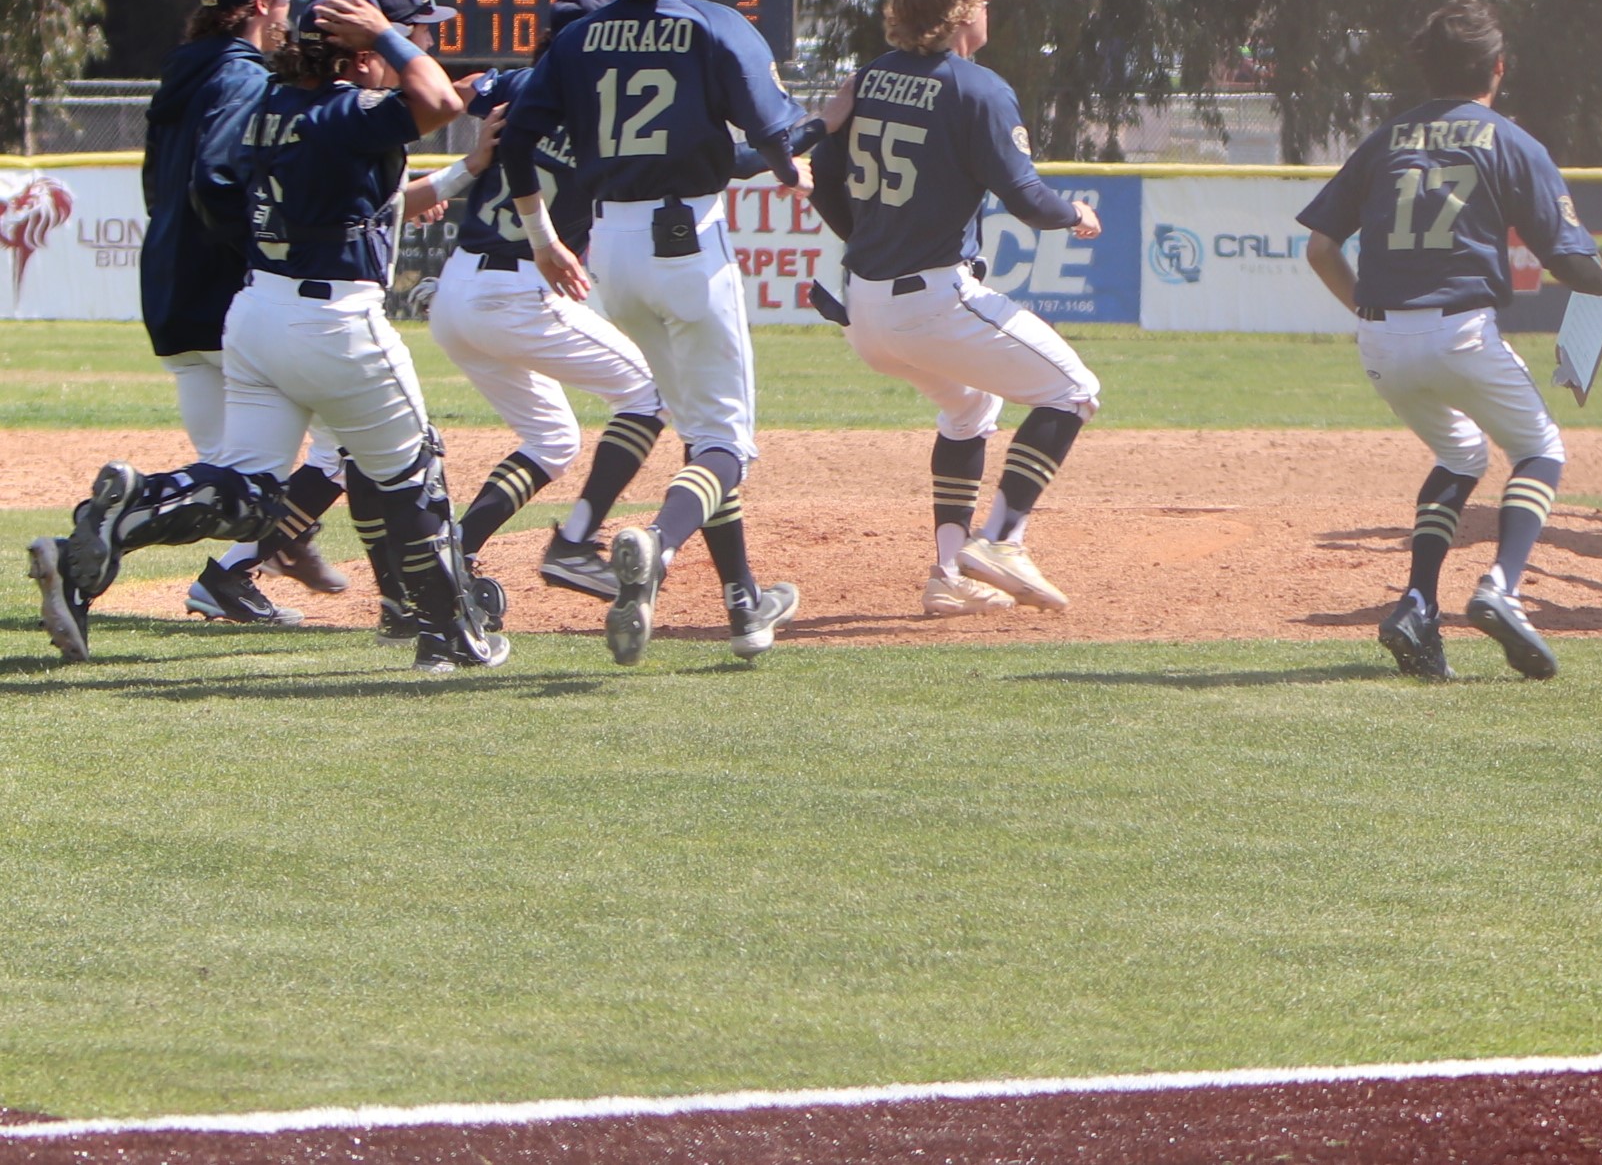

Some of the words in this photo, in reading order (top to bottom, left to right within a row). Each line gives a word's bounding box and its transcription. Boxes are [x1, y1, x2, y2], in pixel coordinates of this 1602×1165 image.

[512, 13, 537, 52] 0
[583, 19, 693, 54] DURAZO
[857, 69, 942, 111] FISHER
[596, 68, 677, 158] 12
[1389, 120, 1495, 151] GARCIA
[847, 116, 928, 207] 55
[1388, 165, 1478, 250] 17
[1038, 300, 1095, 312] 797-1166
